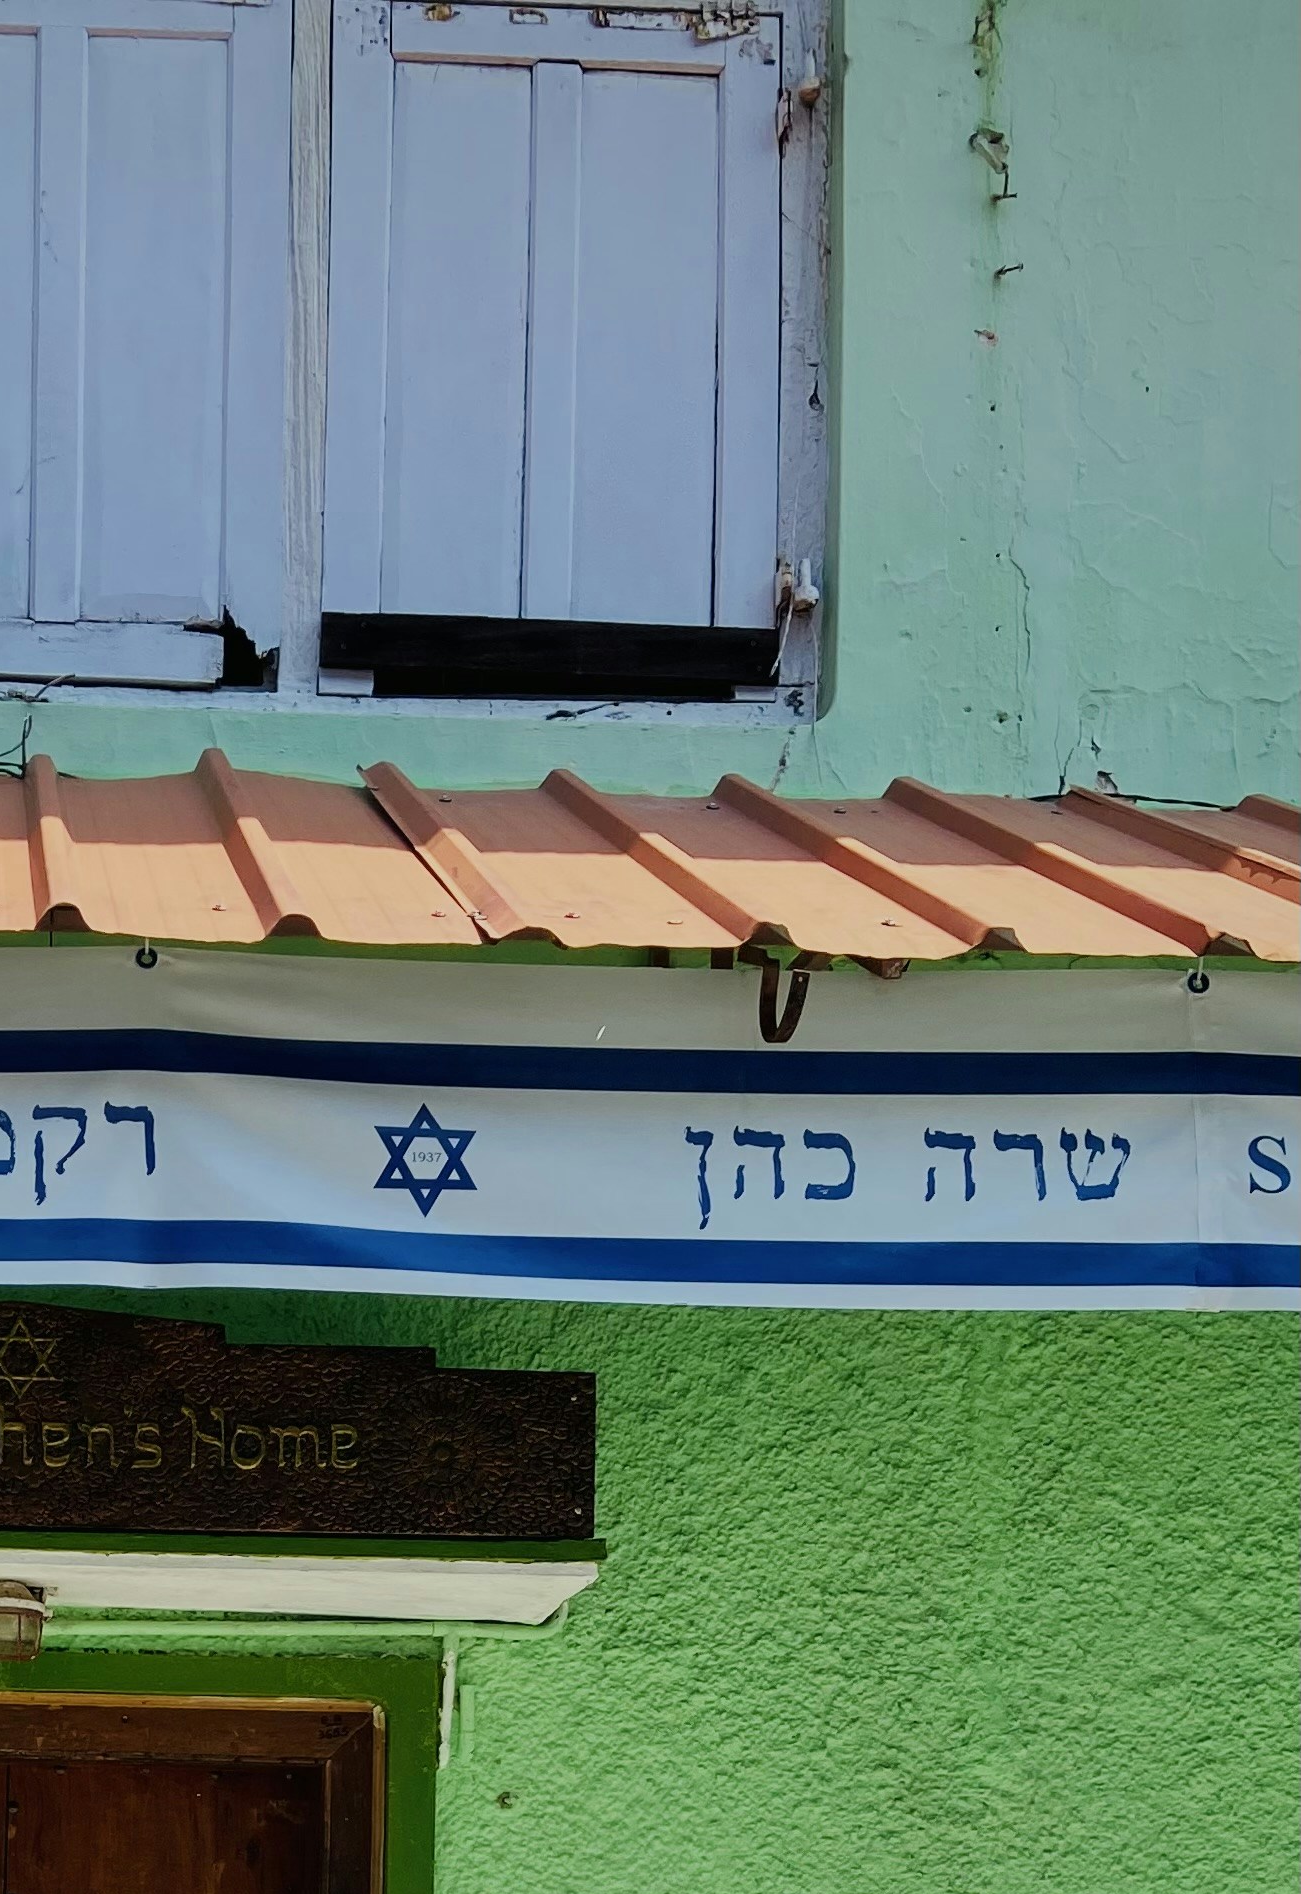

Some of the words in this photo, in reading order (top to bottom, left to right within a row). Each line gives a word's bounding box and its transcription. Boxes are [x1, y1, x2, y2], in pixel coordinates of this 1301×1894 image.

[411, 1151, 443, 1163] 1937
[684, 1125, 856, 1231] כהן
[923, 1126, 1131, 1202] שרה
[181, 1405, 360, 1470] Home
